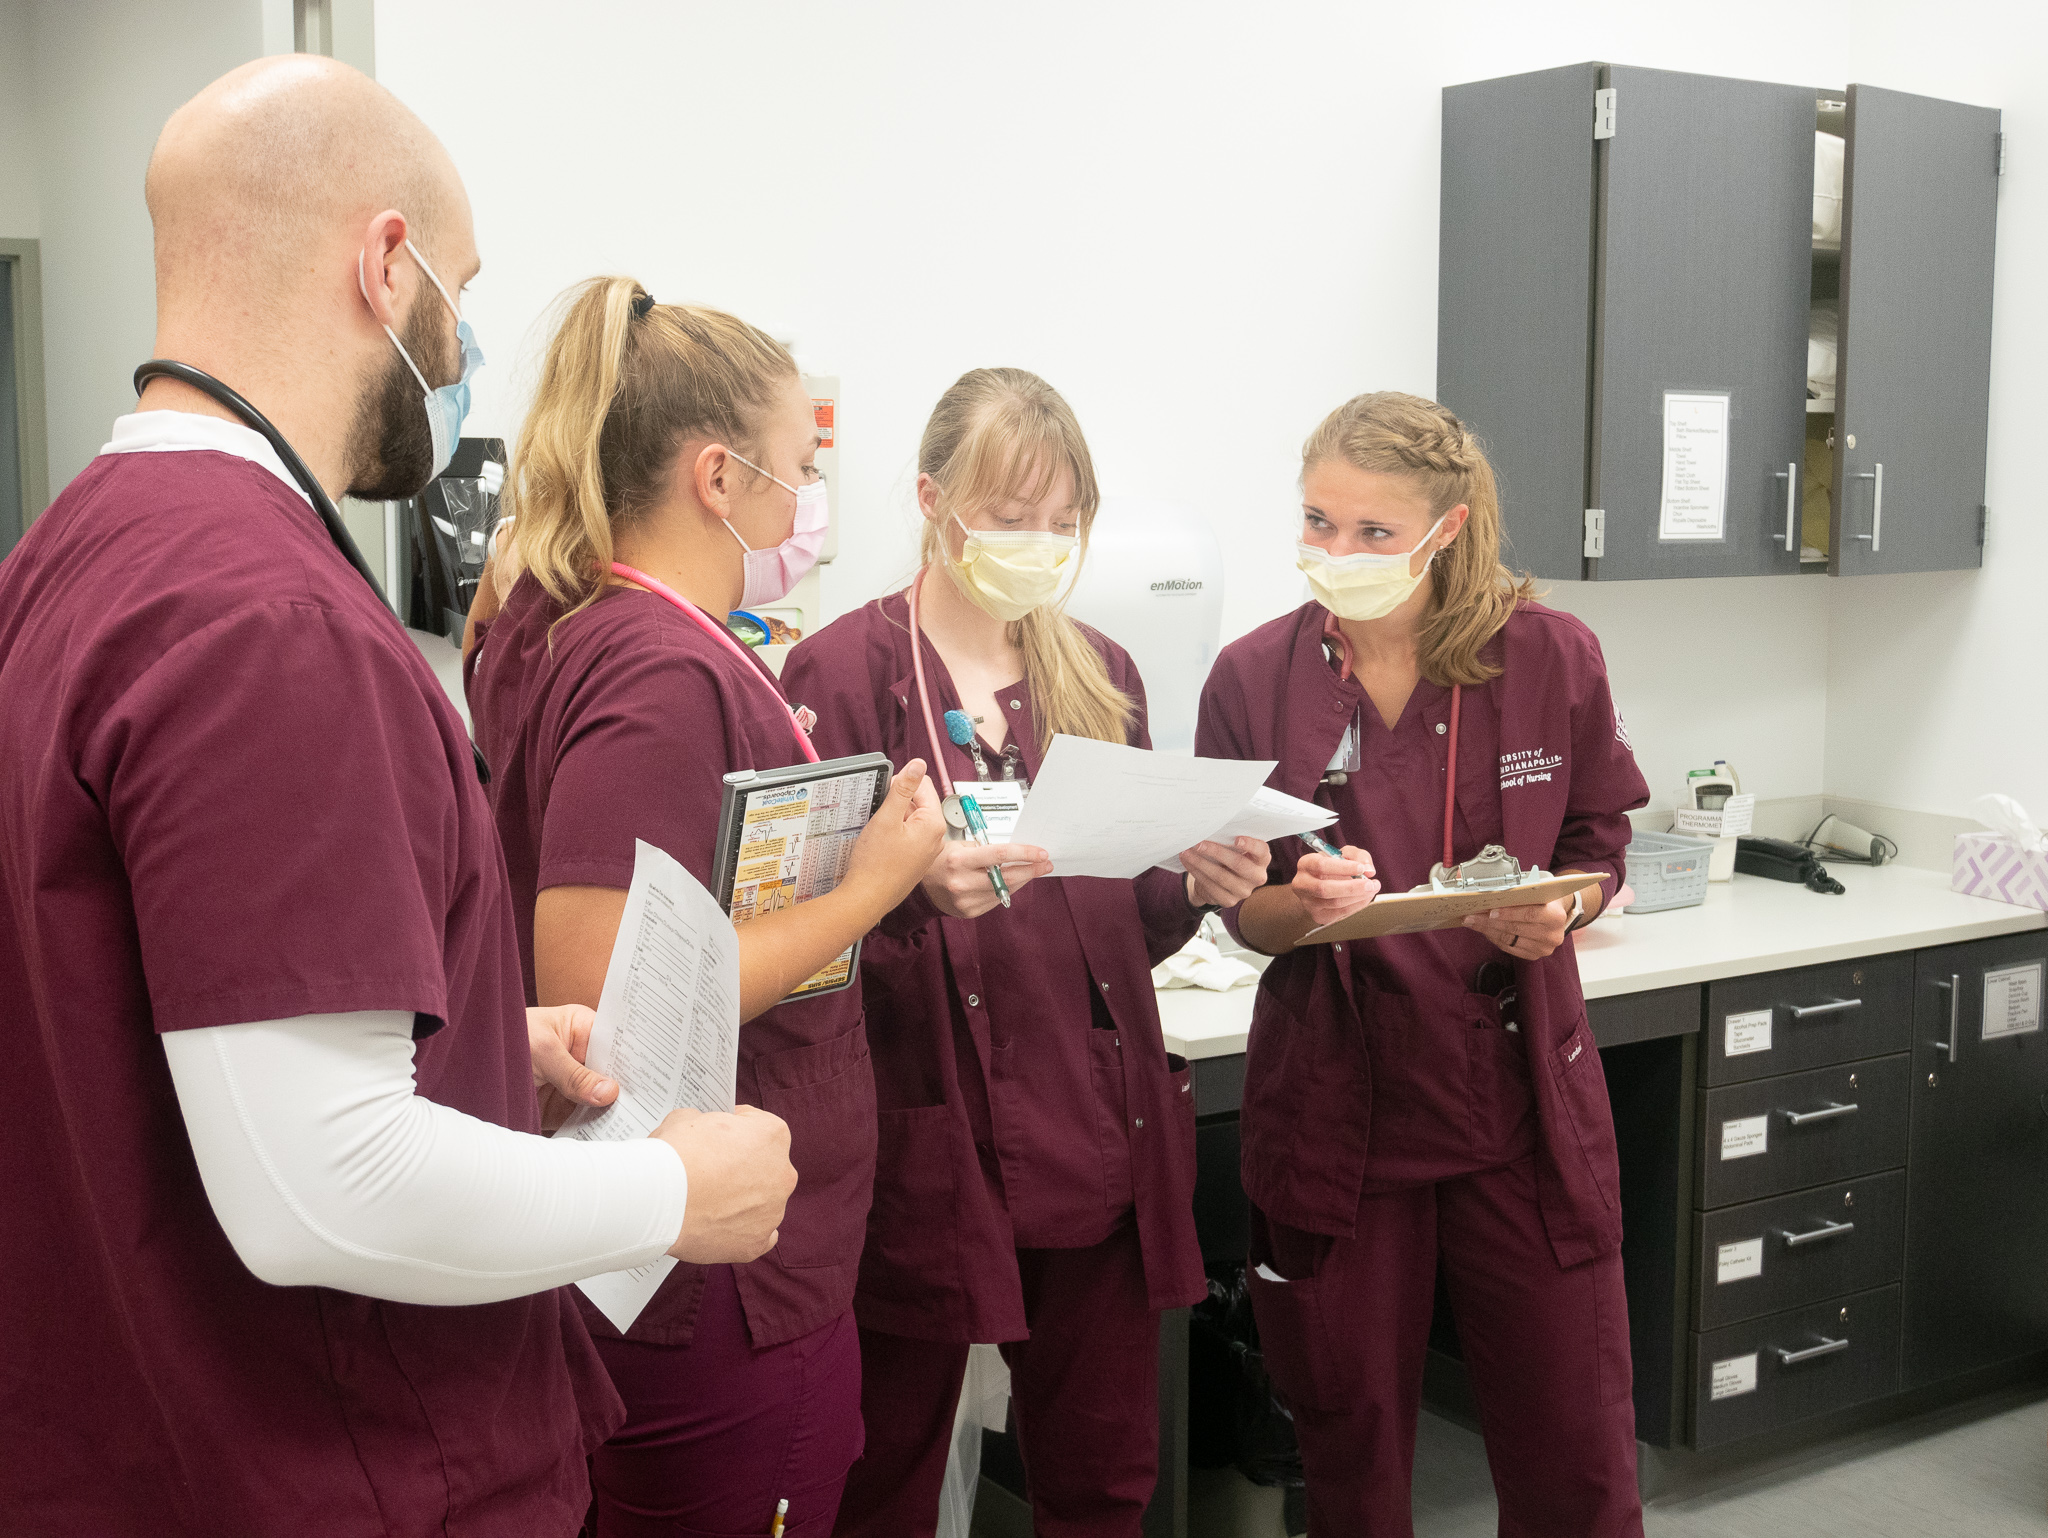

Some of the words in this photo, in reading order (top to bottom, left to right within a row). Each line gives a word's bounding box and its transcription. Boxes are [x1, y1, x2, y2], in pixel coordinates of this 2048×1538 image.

[1150, 578, 1203, 591] enMotion
[1500, 750, 1532, 764] ERSITY
[1533, 747, 1543, 758] of
[1526, 772, 1552, 784] Nursing
